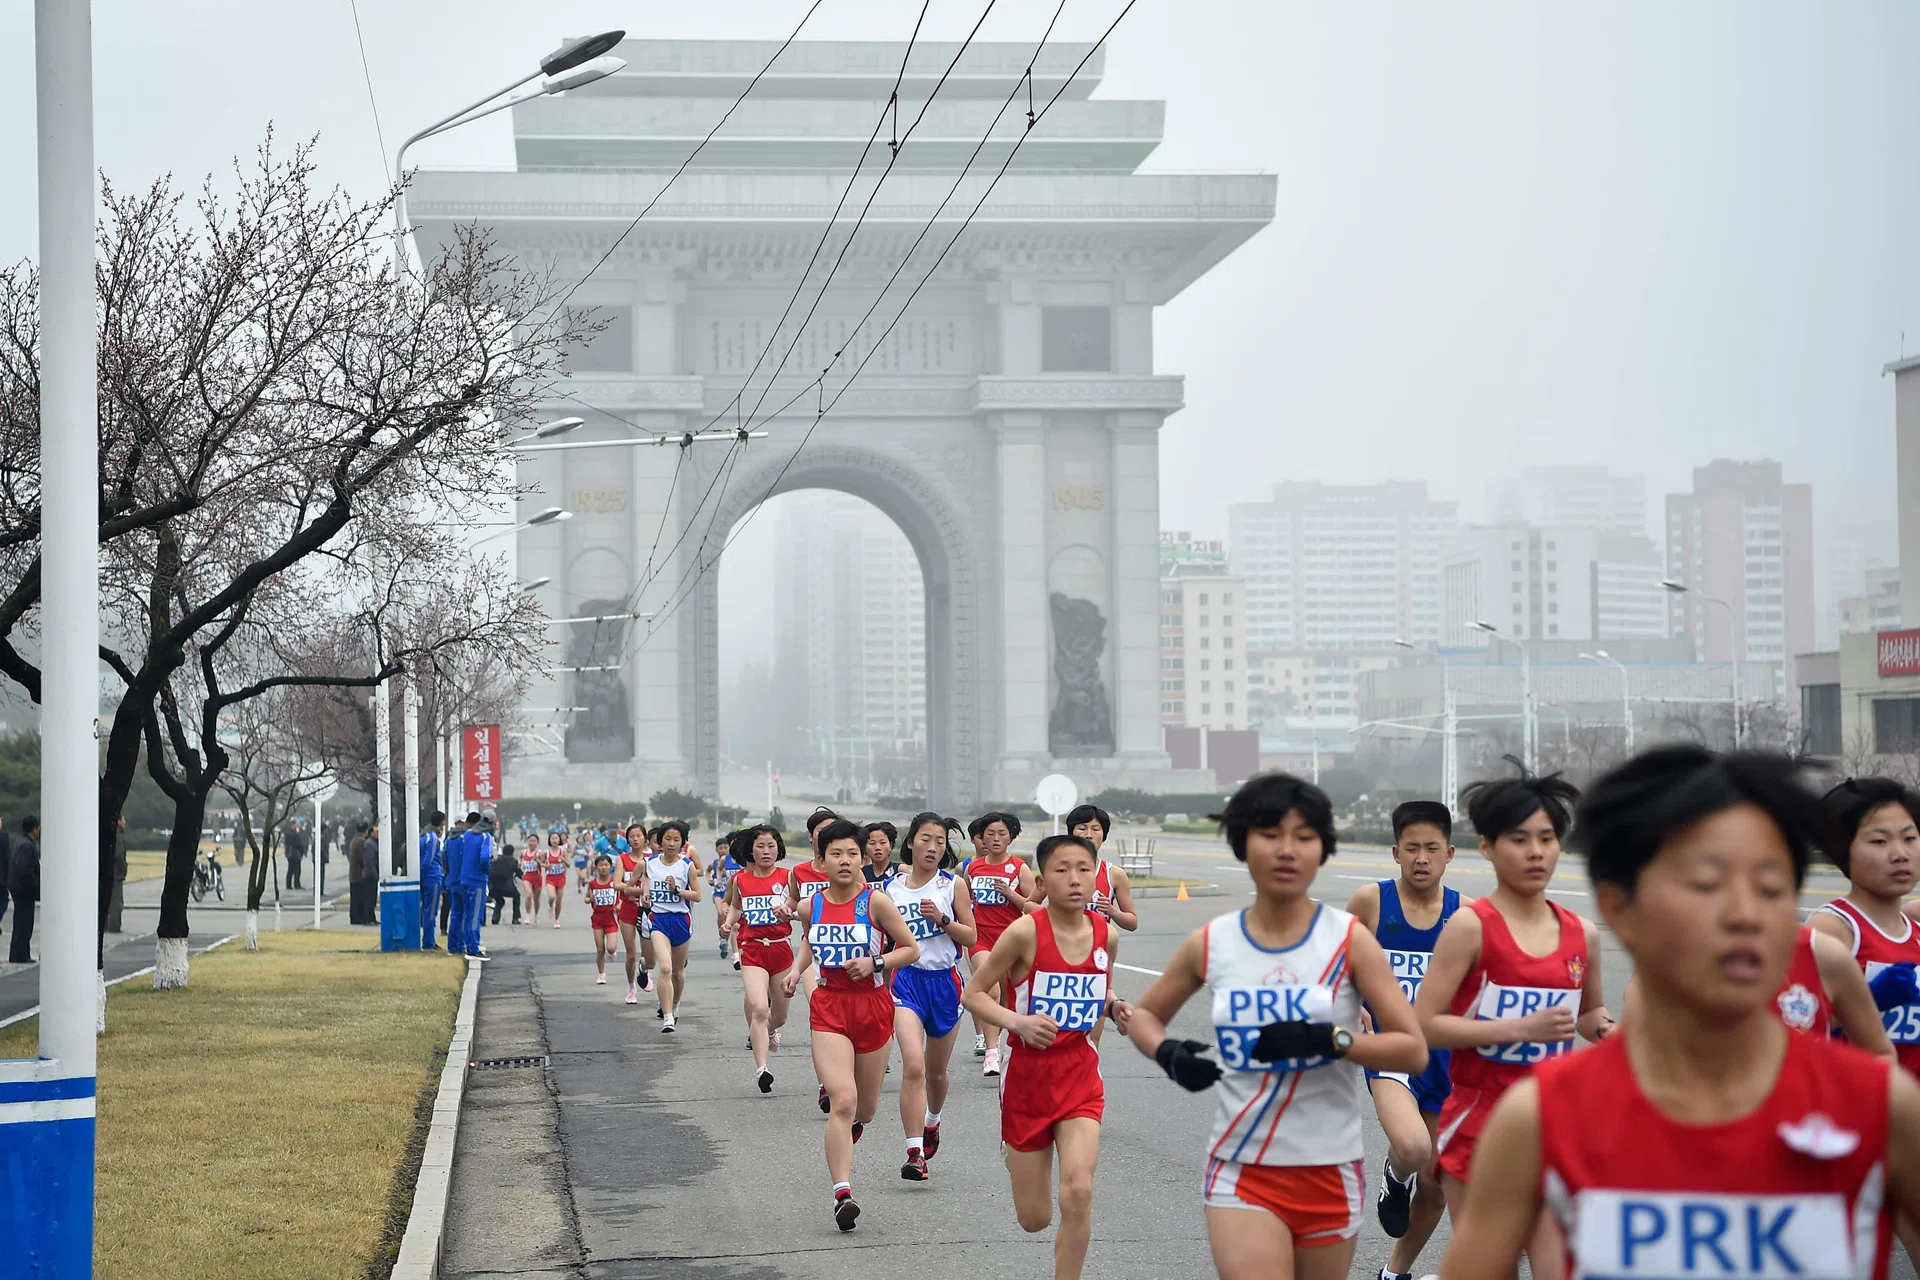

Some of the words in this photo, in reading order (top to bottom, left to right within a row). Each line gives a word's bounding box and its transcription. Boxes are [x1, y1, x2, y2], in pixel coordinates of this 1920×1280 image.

[572, 488, 626, 512] 1925
[1051, 487, 1105, 511] 1945
[806, 882, 830, 896] PR
[976, 877, 994, 889] PR
[594, 897, 614, 907] 3239
[595, 889, 611, 898] PRK
[650, 891, 680, 903] 3216
[747, 896, 773, 910] PRK
[973, 889, 1006, 904] 3246
[743, 910, 779, 925] 3245
[897, 902, 921, 919] PR
[817, 925, 857, 943] PRK
[909, 920, 944, 940] 214
[812, 946, 865, 967] 3210
[1390, 952, 1432, 976] PR
[1046, 974, 1097, 998] PRK
[1230, 988, 1311, 1022] PRK
[1496, 989, 1567, 1018] PRK
[1034, 1000, 1099, 1029] 3054
[1619, 1199, 1804, 1274] PRK
